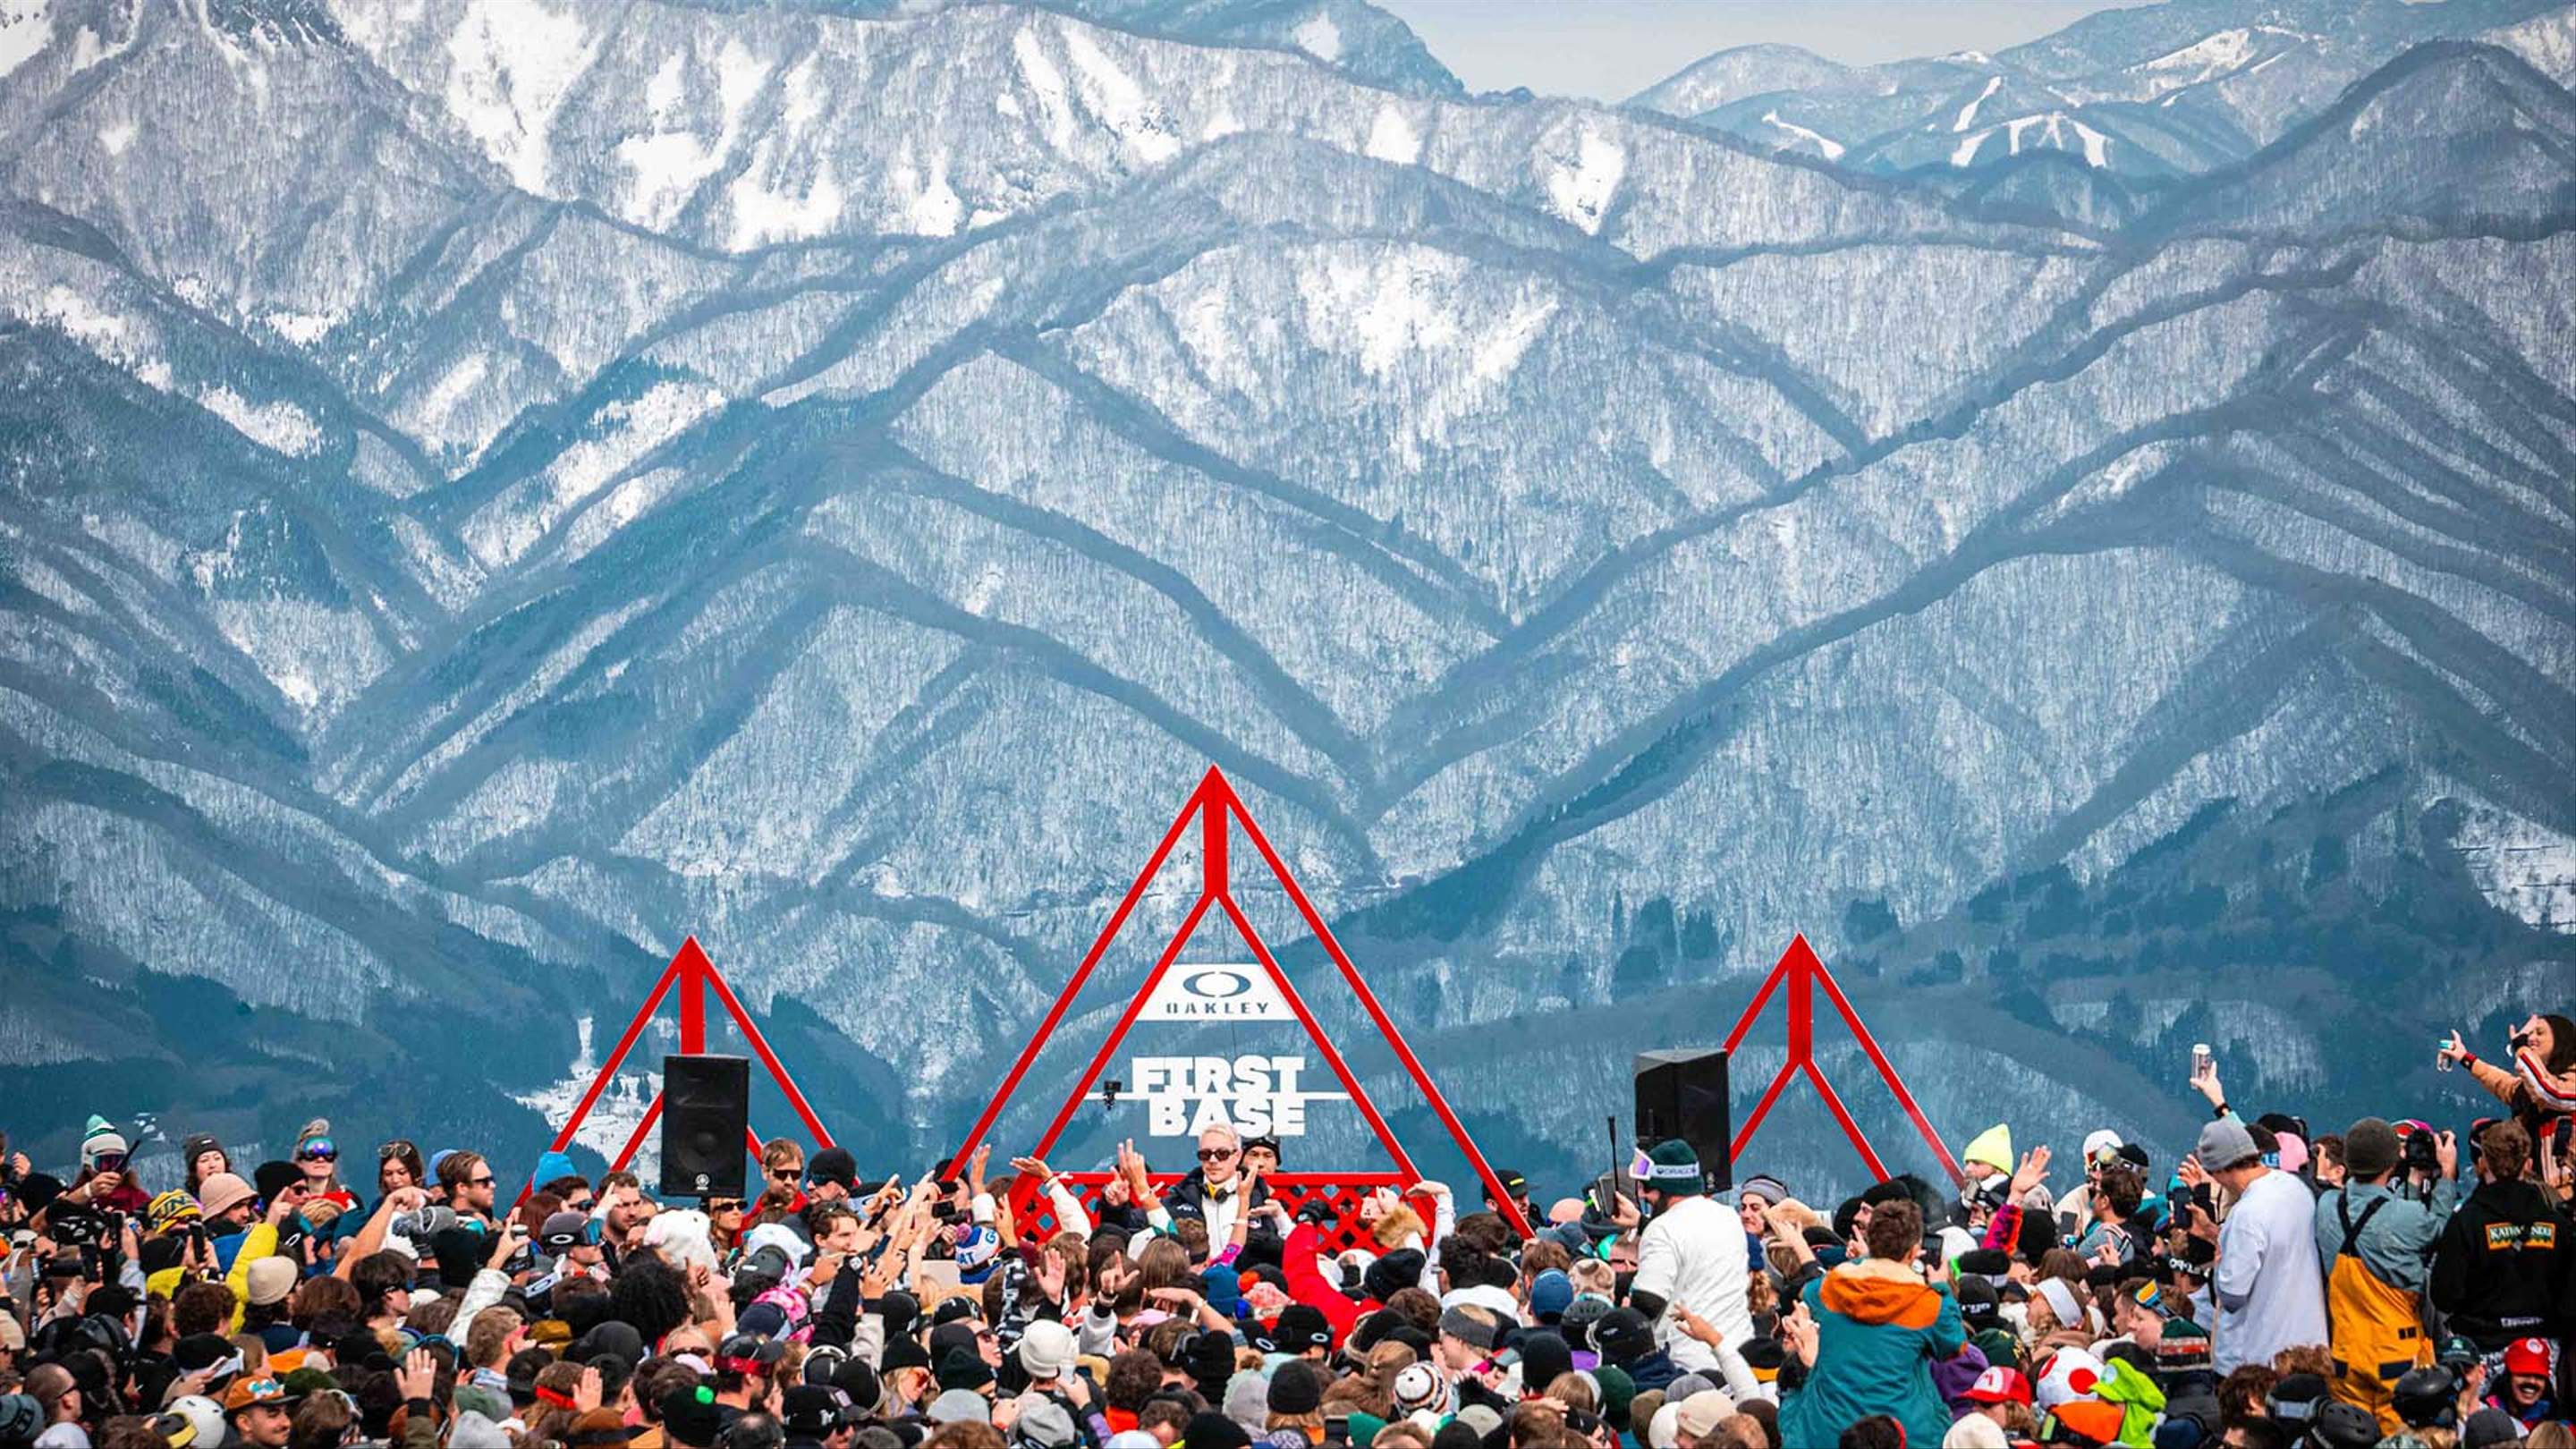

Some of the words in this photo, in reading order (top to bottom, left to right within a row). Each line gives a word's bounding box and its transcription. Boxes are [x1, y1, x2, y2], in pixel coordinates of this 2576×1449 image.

[1166, 1002, 1268, 1014] OAKLEY
[1131, 1055, 1305, 1097] FIRST
[1149, 1094, 1305, 1137] BASE
